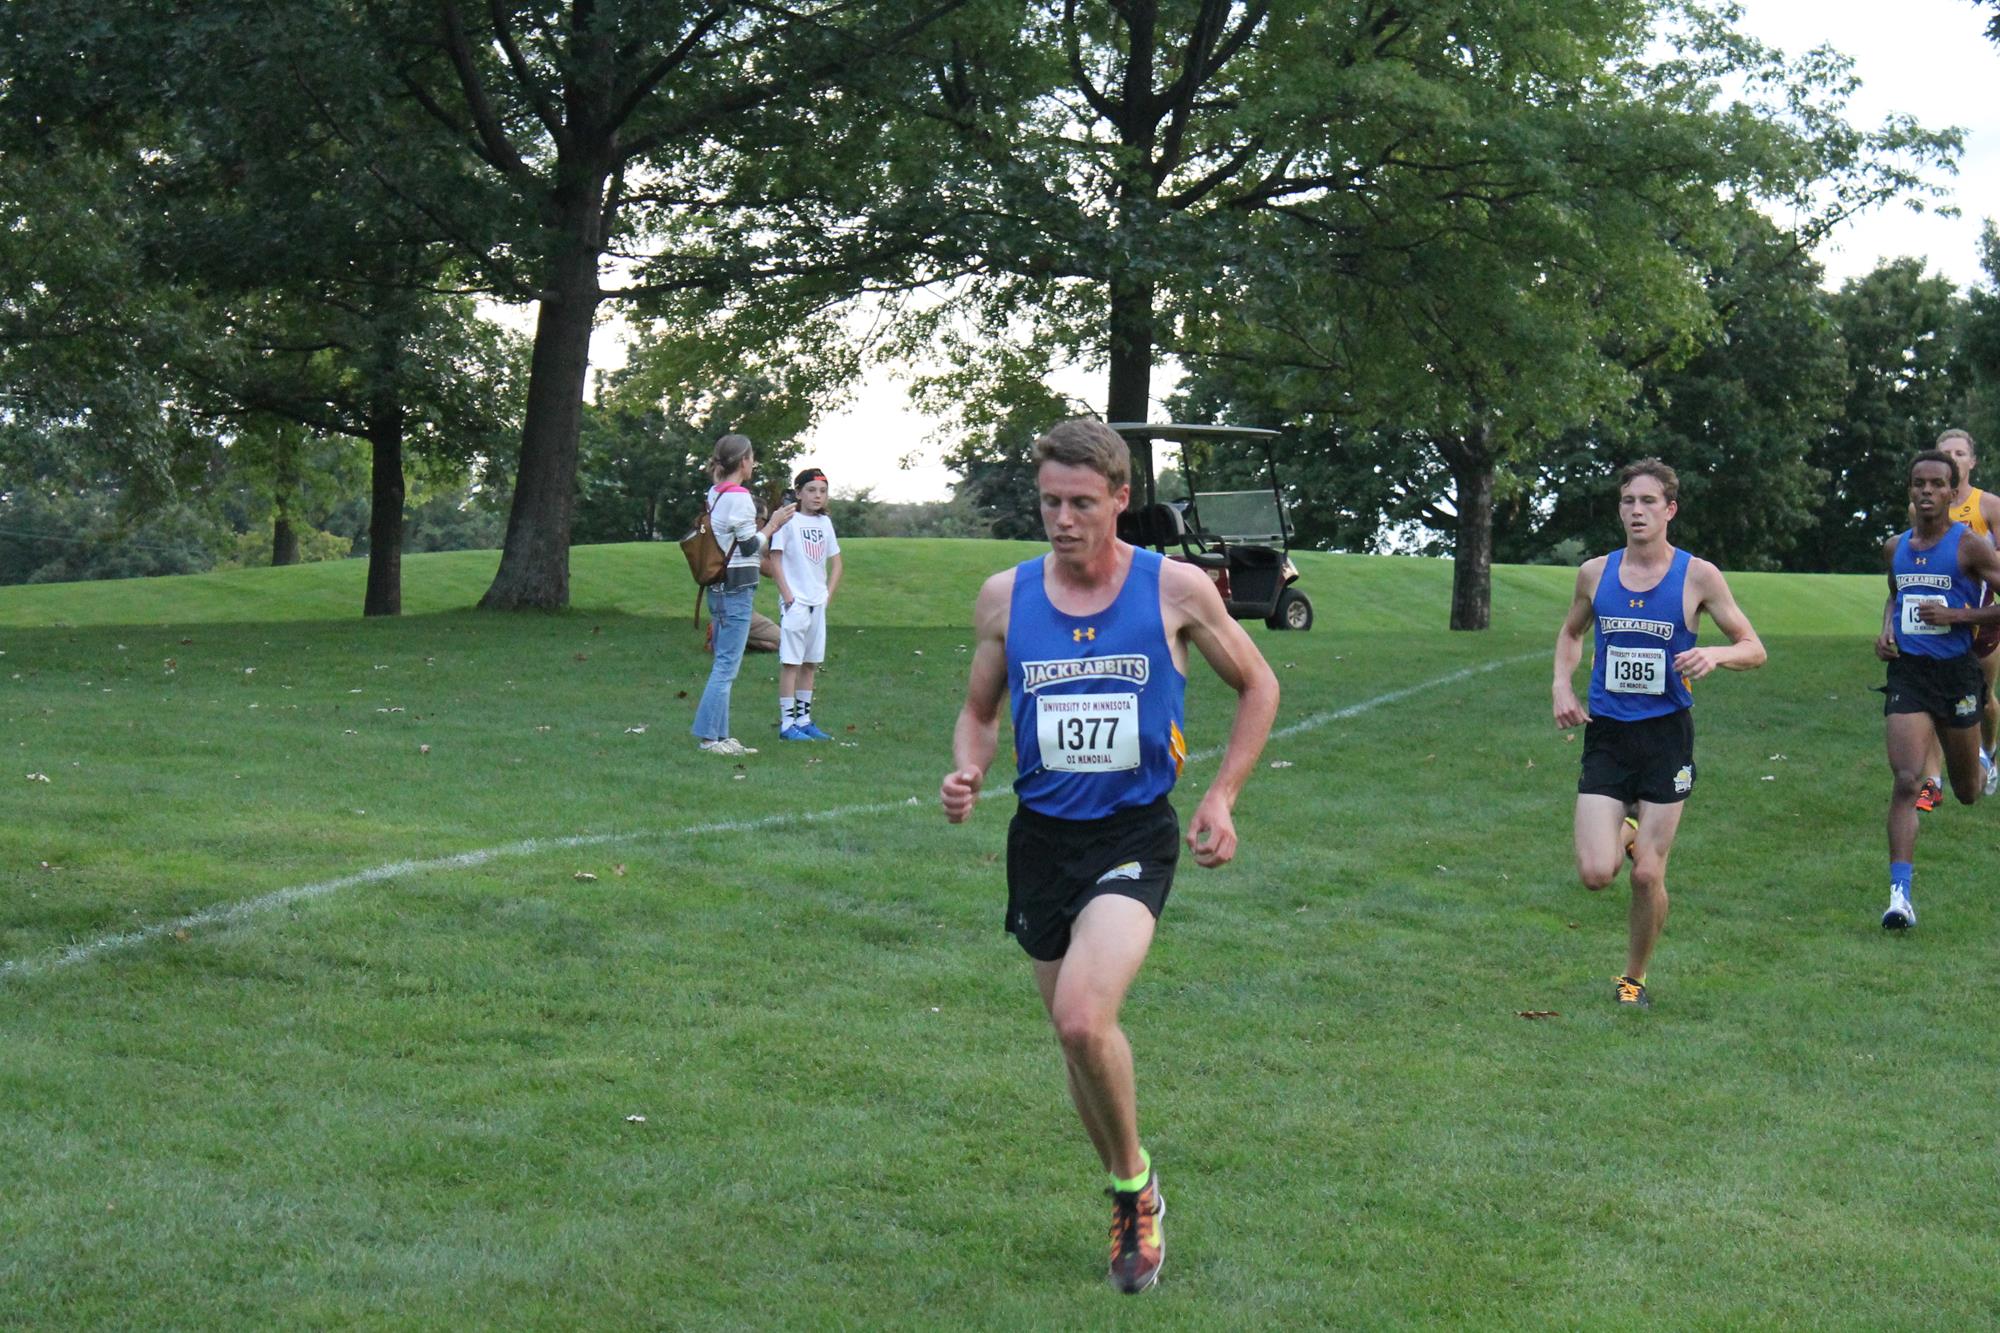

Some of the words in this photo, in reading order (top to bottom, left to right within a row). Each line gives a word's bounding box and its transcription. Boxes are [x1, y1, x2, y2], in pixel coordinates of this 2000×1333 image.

[803, 529, 824, 542] USA
[1909, 606, 1921, 623] 13
[1600, 617, 1672, 638] JACKRABBITS
[1025, 657, 1147, 688] JACKRABBITS
[1614, 661, 1655, 681] 1385
[1043, 702, 1080, 712] UNIVERSITY
[1082, 702, 1091, 711] OF
[1093, 701, 1131, 711] MINNESOTA
[1058, 717, 1119, 750] 1377
[1078, 754, 1112, 764] MEMORIAL
